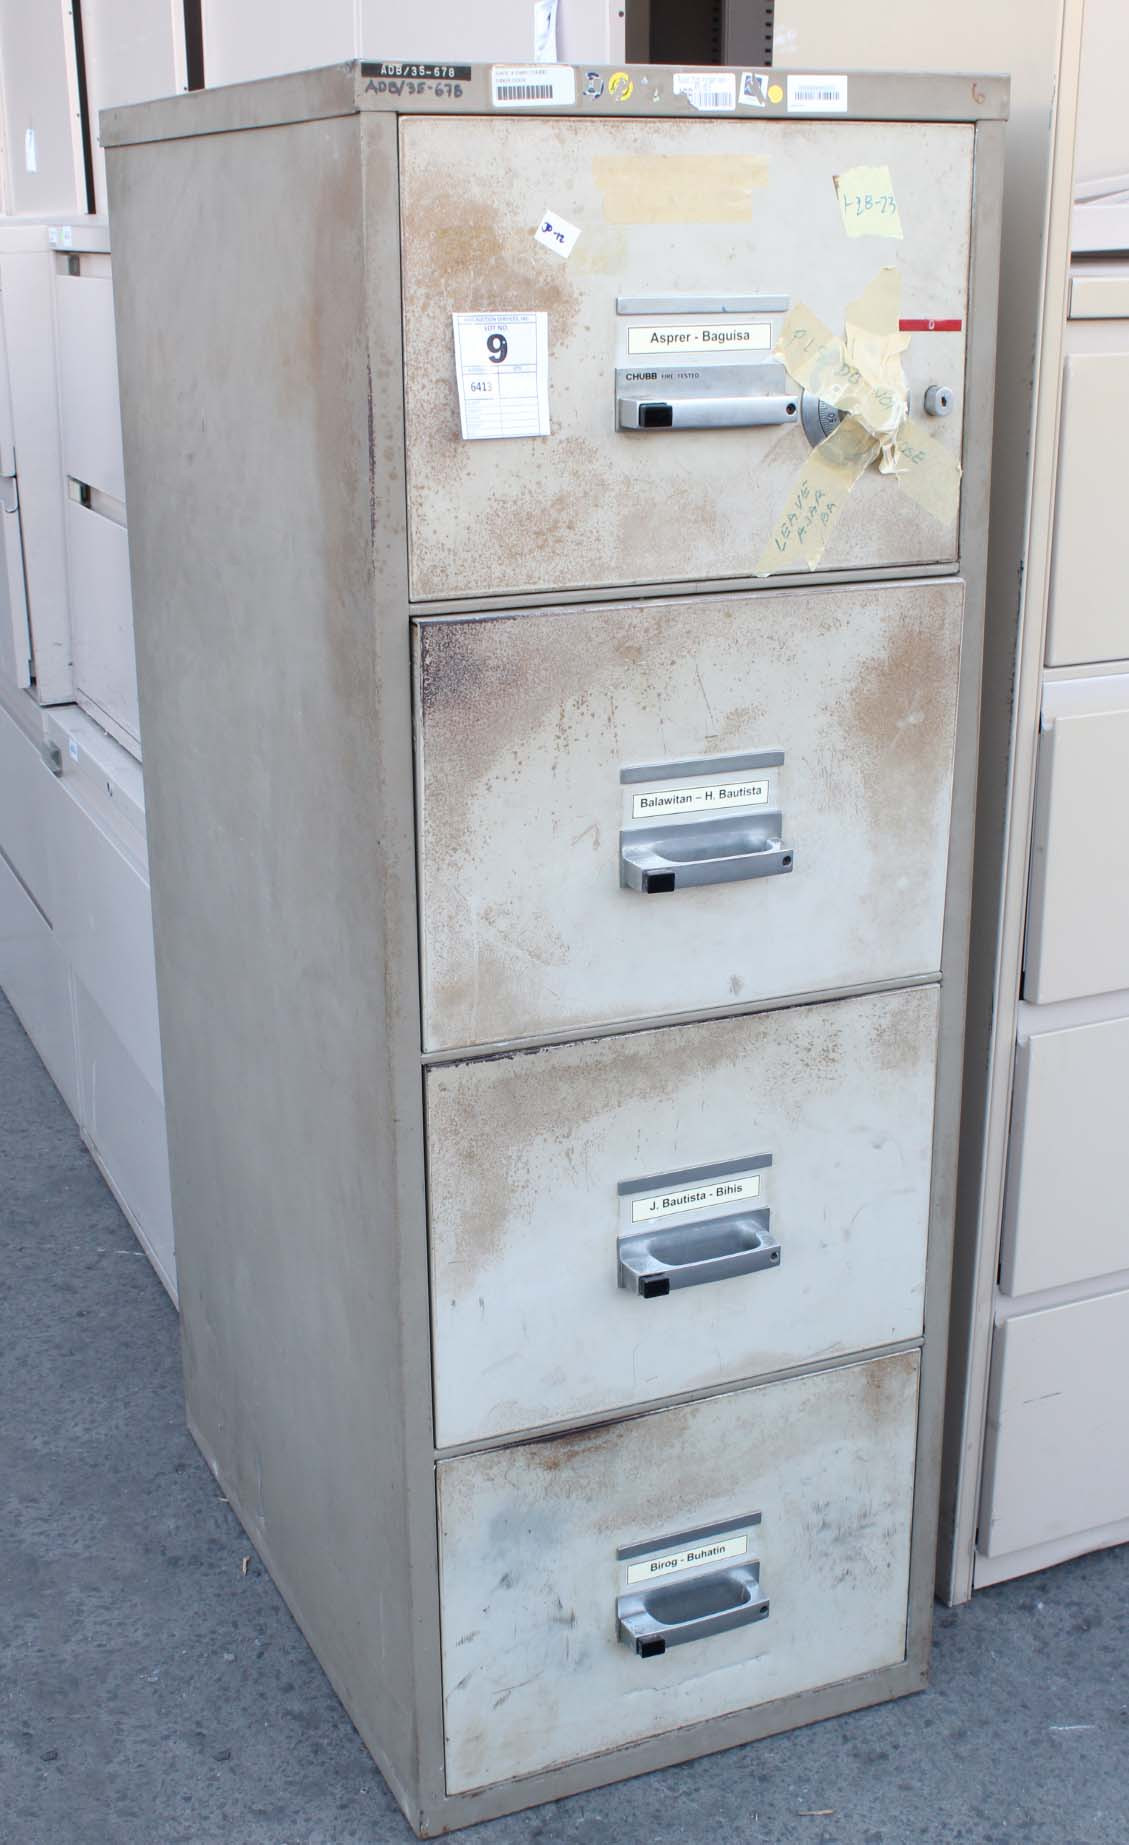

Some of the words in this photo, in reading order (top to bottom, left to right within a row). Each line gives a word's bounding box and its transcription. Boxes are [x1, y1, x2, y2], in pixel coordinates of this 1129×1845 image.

[486, 333, 508, 364] 9
[650, 332, 691, 346] Asprer
[702, 329, 750, 344] Baguisa
[625, 372, 657, 381] CHUBB
[640, 794, 693, 808] Balawitan
[719, 786, 762, 799] Bautista
[662, 1191, 706, 1208] Bautista
[716, 1184, 743, 1197] Bihis
[650, 1559, 678, 1572] Birog
[686, 1545, 726, 1562] Buhatin
